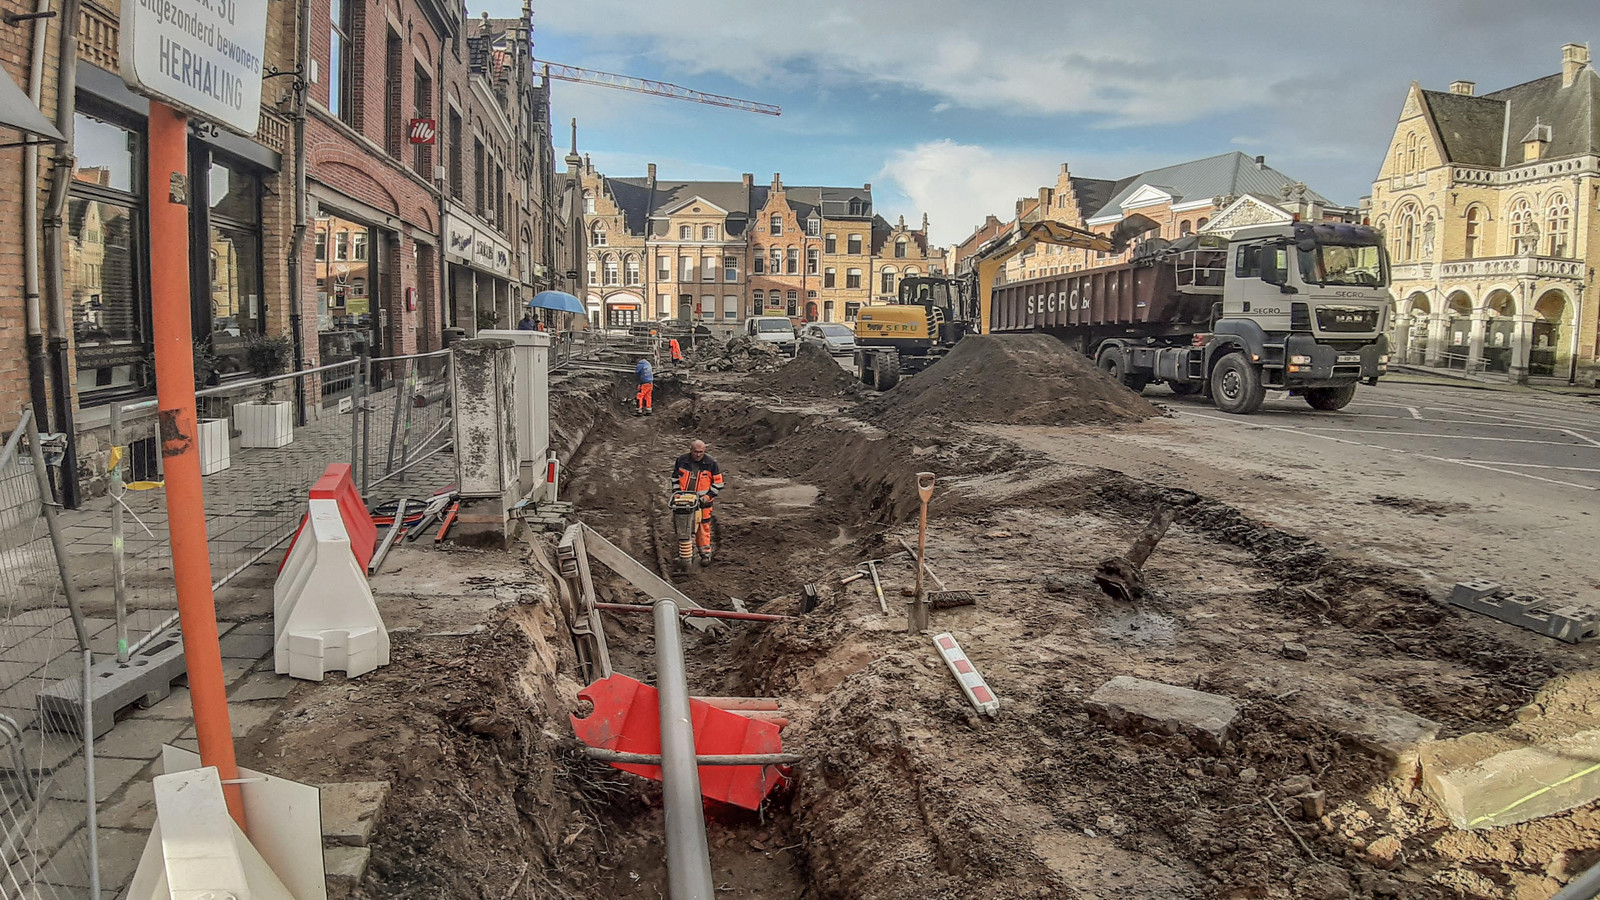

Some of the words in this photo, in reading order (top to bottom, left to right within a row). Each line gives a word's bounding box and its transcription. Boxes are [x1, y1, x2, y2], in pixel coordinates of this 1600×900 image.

[216, 27, 260, 75] bewoners
[159, 34, 243, 111] HERHALING
[411, 122, 434, 142] illy
[1335, 315, 1363, 323] MAN
